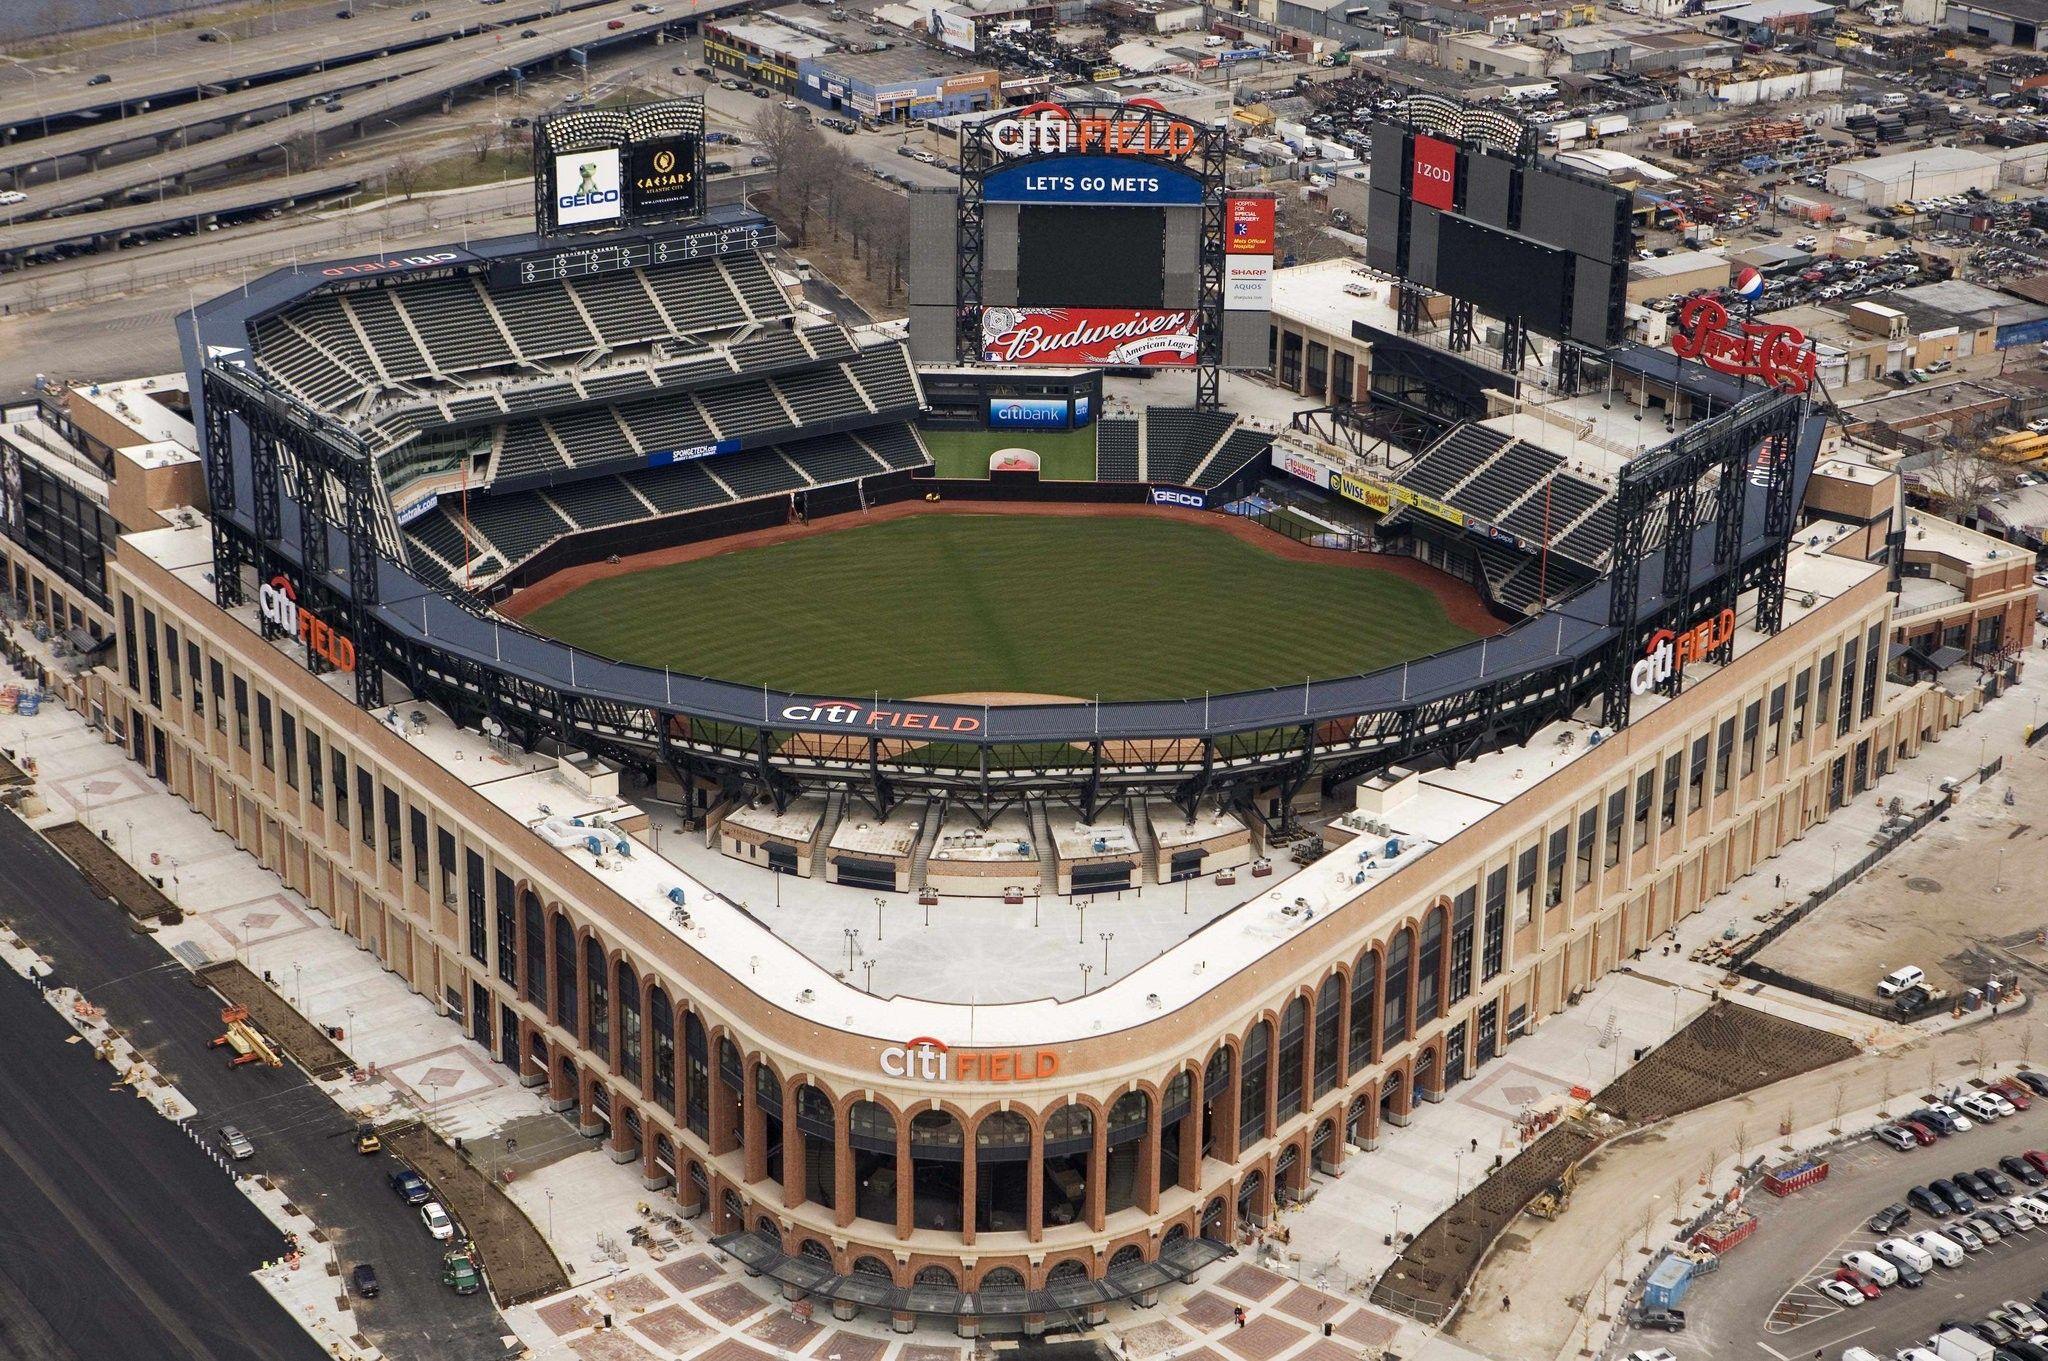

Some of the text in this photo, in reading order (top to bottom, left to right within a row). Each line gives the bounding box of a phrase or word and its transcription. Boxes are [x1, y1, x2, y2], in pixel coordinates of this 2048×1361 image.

[992, 102, 1195, 155] citi FIELD
[636, 172, 692, 189] CAESARS
[1417, 161, 1451, 182] IZOD
[1026, 176, 1159, 192] LET'S GO METS
[559, 189, 619, 209] GEICO
[322, 259, 402, 276] FIELD
[1234, 283, 1262, 291] AQUOS
[994, 312, 1185, 361] Budweiser
[1124, 339, 1194, 358] American Lager
[998, 404, 1059, 420] citibank
[1292, 459, 1318, 475] DUNKIN'
[1292, 466, 1317, 482] DONUTS
[1154, 490, 1203, 507] GEICO
[1342, 478, 1364, 501] WISE
[260, 576, 356, 673] citi FIELD
[1630, 608, 1735, 696] citi FIELD
[782, 701, 981, 731] citi FIELD
[879, 1036, 1060, 1082] citi FIELD
